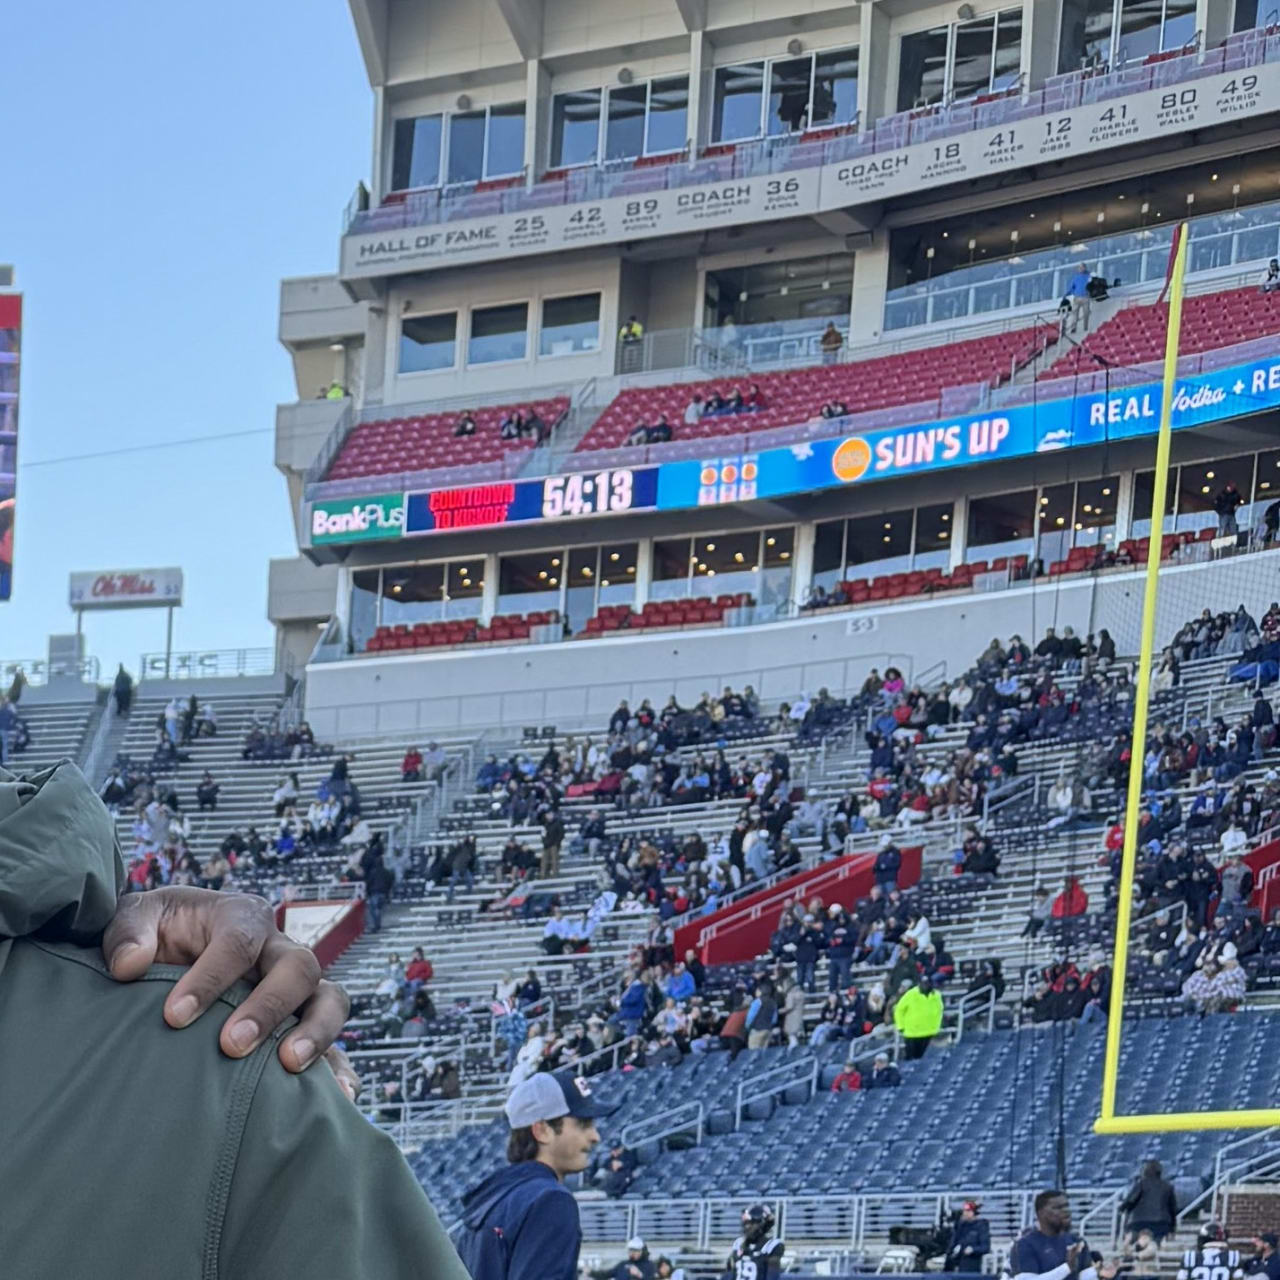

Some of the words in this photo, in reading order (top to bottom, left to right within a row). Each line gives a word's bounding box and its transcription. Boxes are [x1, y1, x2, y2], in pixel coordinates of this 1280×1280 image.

[1222, 75, 1258, 95] 49
[1161, 89, 1197, 109] 80
[1216, 91, 1261, 106] PATRICK
[1220, 100, 1256, 114] WILLIS
[1099, 104, 1128, 122] 41
[1045, 117, 1072, 136] 12
[1089, 127, 1139, 143] FLOWERS
[1092, 119, 1137, 134] CHARLIE
[989, 130, 1016, 147] 41
[933, 143, 961, 161] 18
[838, 155, 909, 181] COACH
[677, 185, 752, 207] COACH
[766, 178, 800, 195] 36
[569, 207, 603, 224] 42
[625, 199, 659, 216] 89
[514, 215, 546, 233] 25
[360, 238, 411, 258] HALL
[414, 233, 442, 250] OF
[444, 226, 497, 245] FAME
[1090, 394, 1155, 426] REAL
[875, 426, 961, 471] SUN'S
[968, 417, 1010, 455] UP
[429, 484, 516, 511] COUNTDOWN
[543, 471, 634, 518] 54:13
[312, 503, 405, 536] BankPlus
[434, 509, 452, 530] TO
[453, 505, 509, 528] KICKOFF
